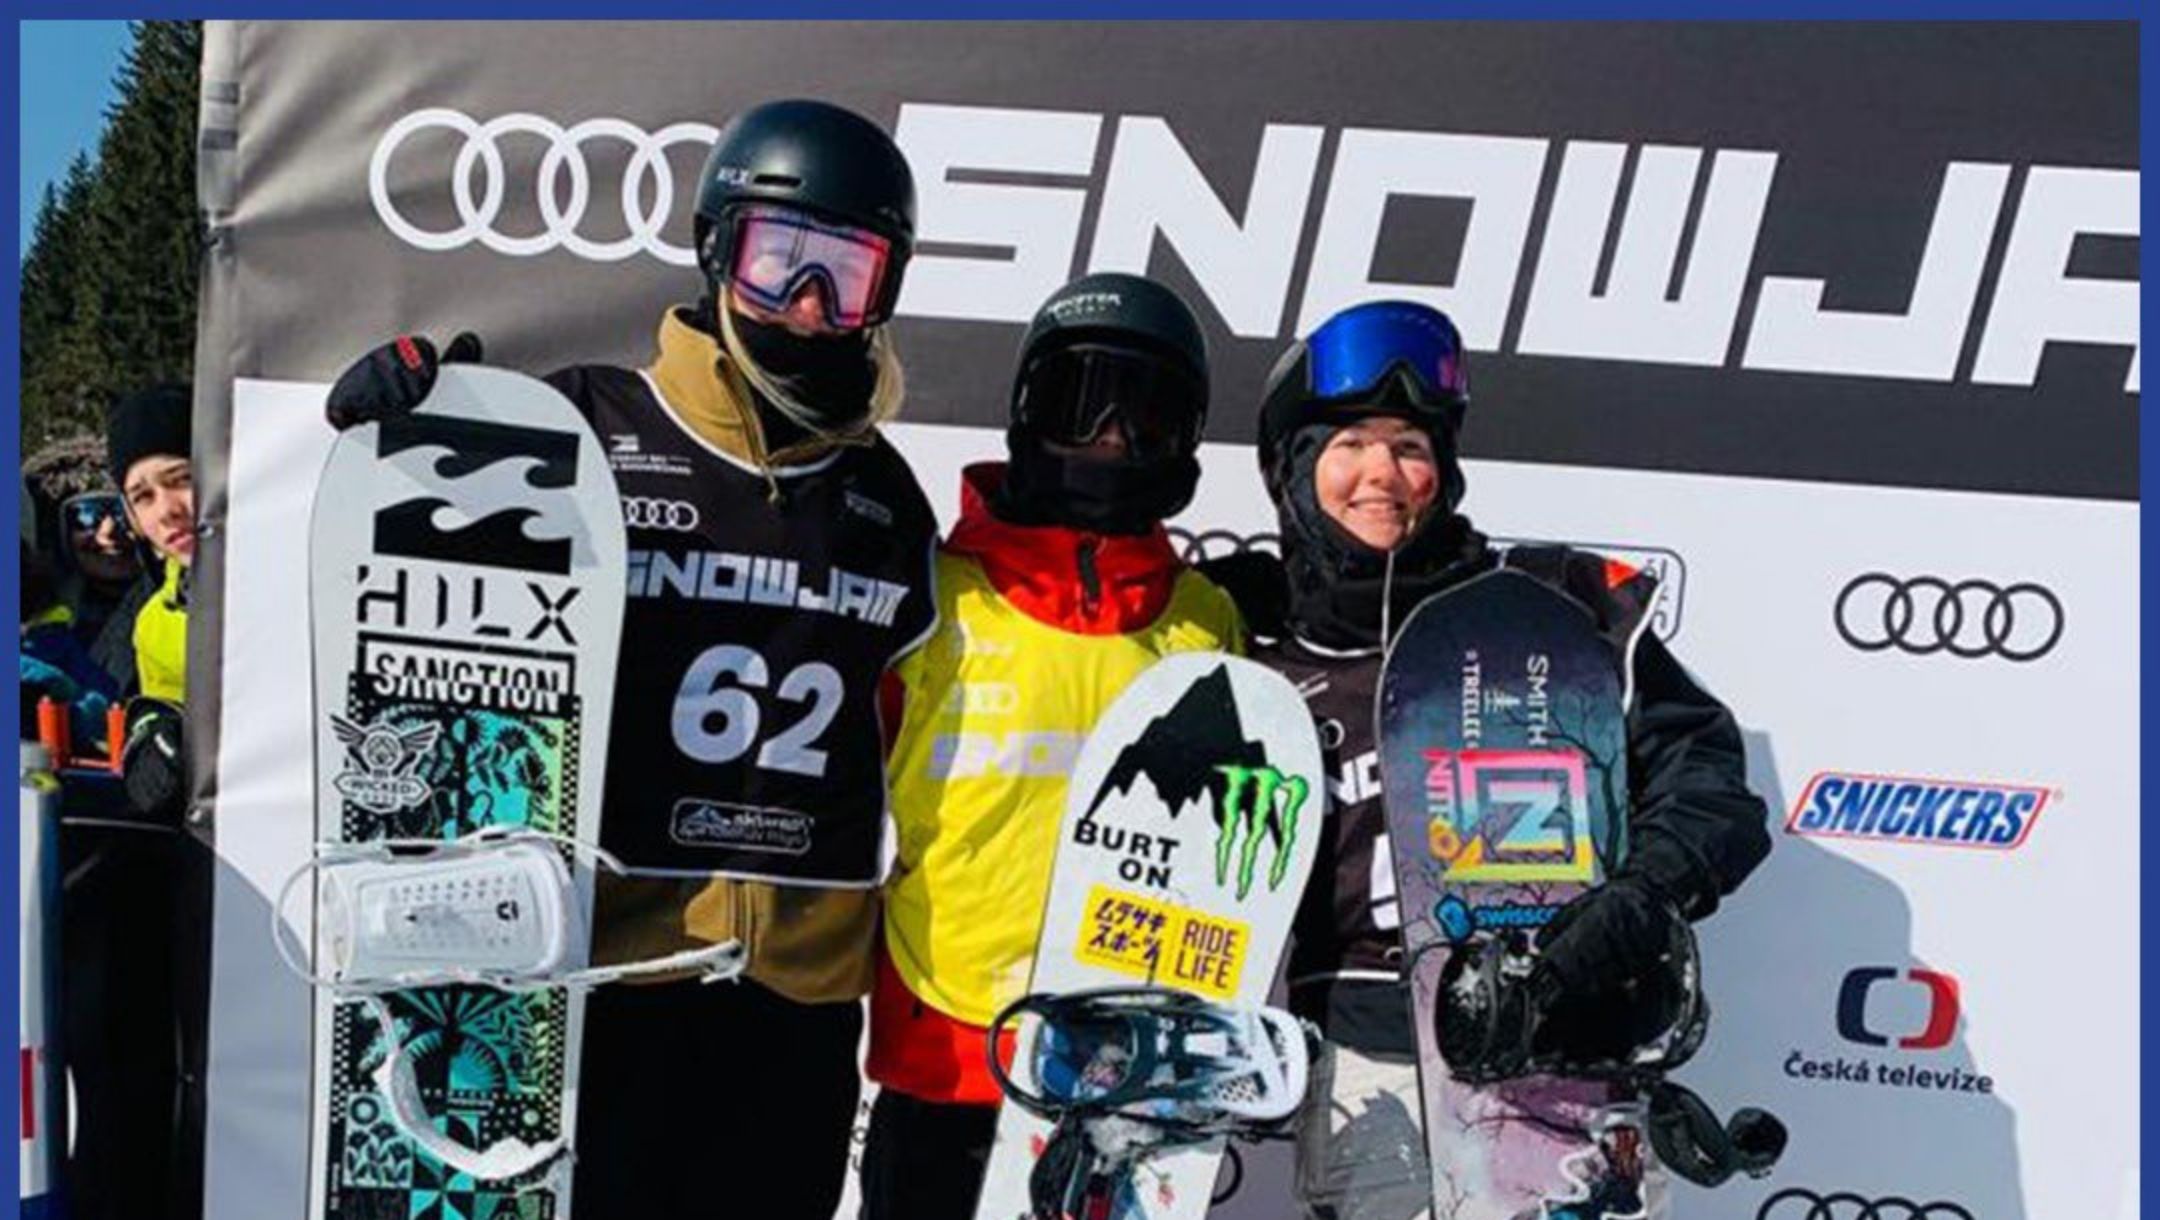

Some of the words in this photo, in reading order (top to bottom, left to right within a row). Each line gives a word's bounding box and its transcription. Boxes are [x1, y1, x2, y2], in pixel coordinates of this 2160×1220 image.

[373, 653, 559, 712] SANCTION
[1527, 654, 1549, 746] SMITH
[671, 644, 844, 776] 62
[1799, 777, 2037, 845] SNICKERS
[1074, 817, 1180, 864] BURT
[1118, 858, 1171, 889] ON
[1095, 898, 1167, 933] ムラサキ
[1182, 918, 1238, 958] RIDE
[1174, 950, 1233, 989] LIFE
[1784, 1049, 1870, 1083] Česká
[1877, 1064, 1994, 1093] televize
